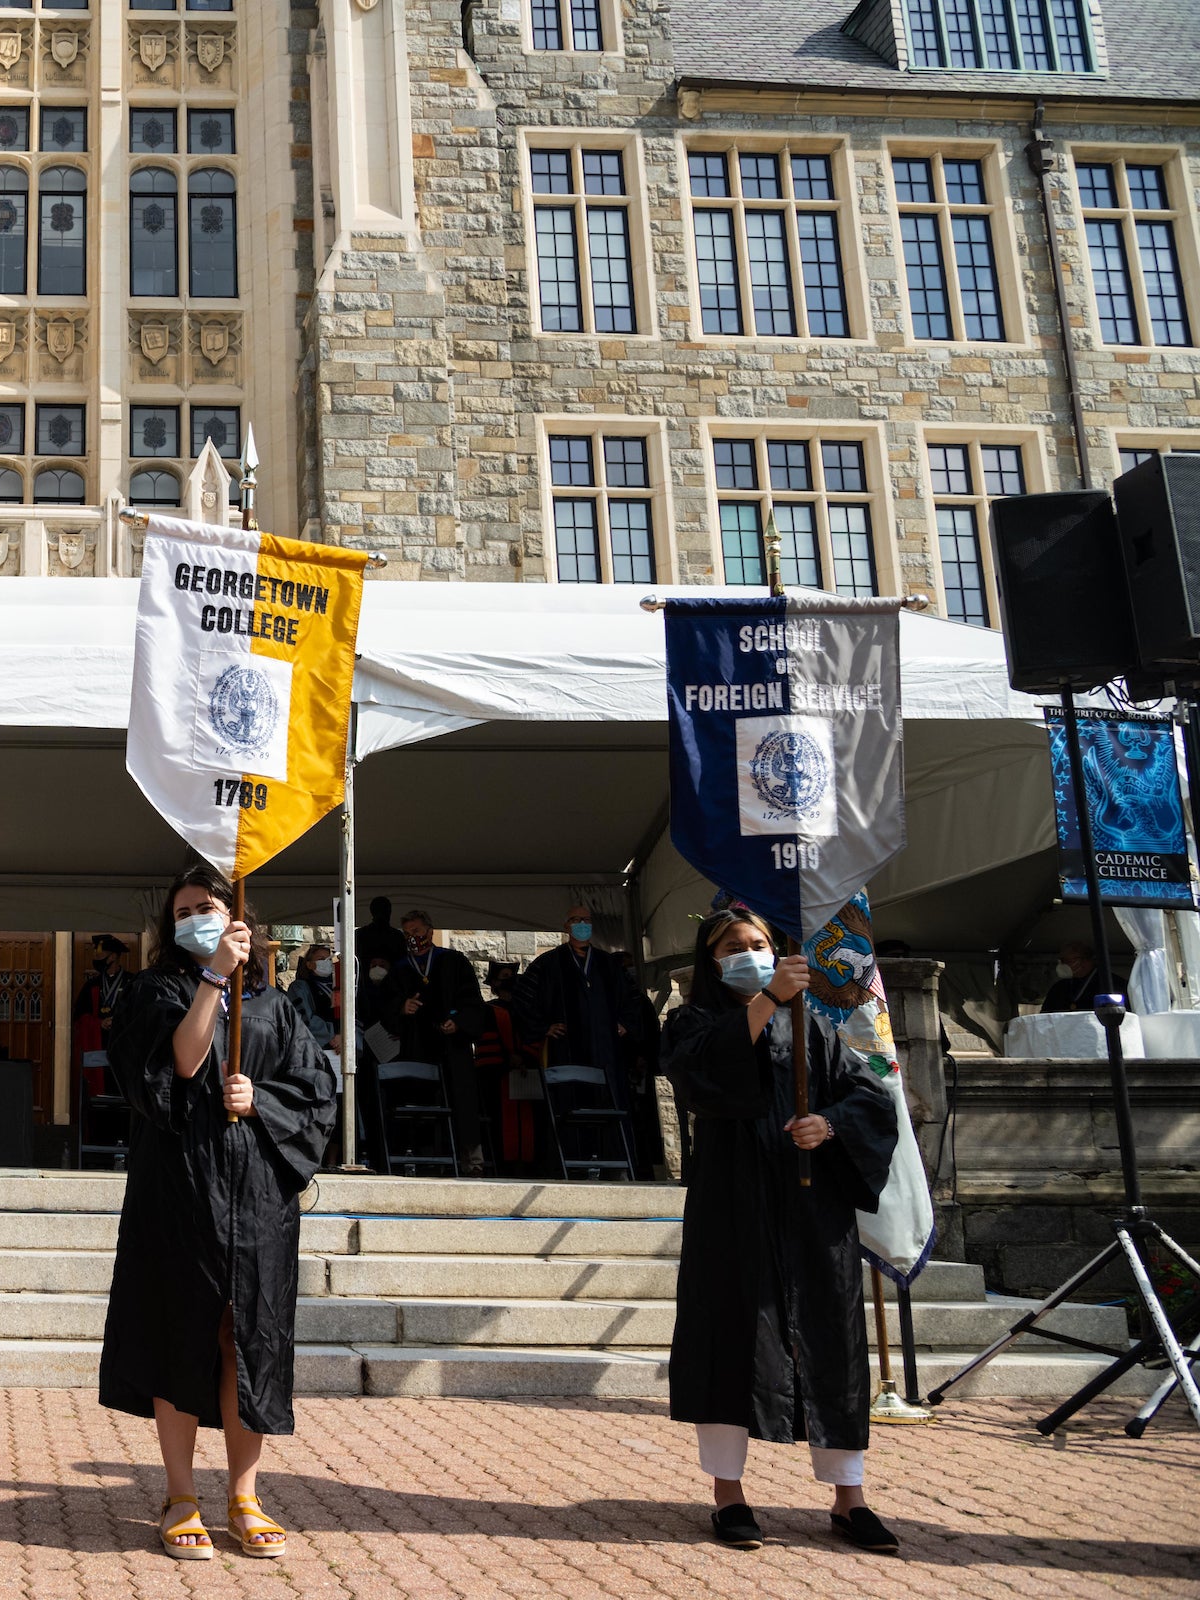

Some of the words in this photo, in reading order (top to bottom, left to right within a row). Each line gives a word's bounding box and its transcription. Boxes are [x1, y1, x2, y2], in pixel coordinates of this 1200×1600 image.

[174, 562, 329, 615] GEORGETOWN
[200, 605, 300, 646] COLLEGE
[739, 624, 826, 653] SCHOOL
[775, 657, 799, 675] OF
[685, 682, 784, 712] FOREIGN
[793, 683, 882, 712] SERVICE
[1095, 710, 1108, 719] OF
[1109, 711, 1170, 721] GERGETOWN
[214, 779, 267, 811] 1789
[771, 842, 820, 870] 1919
[1095, 853, 1161, 867] CADEMIC
[1098, 866, 1168, 879] CELLENCE
